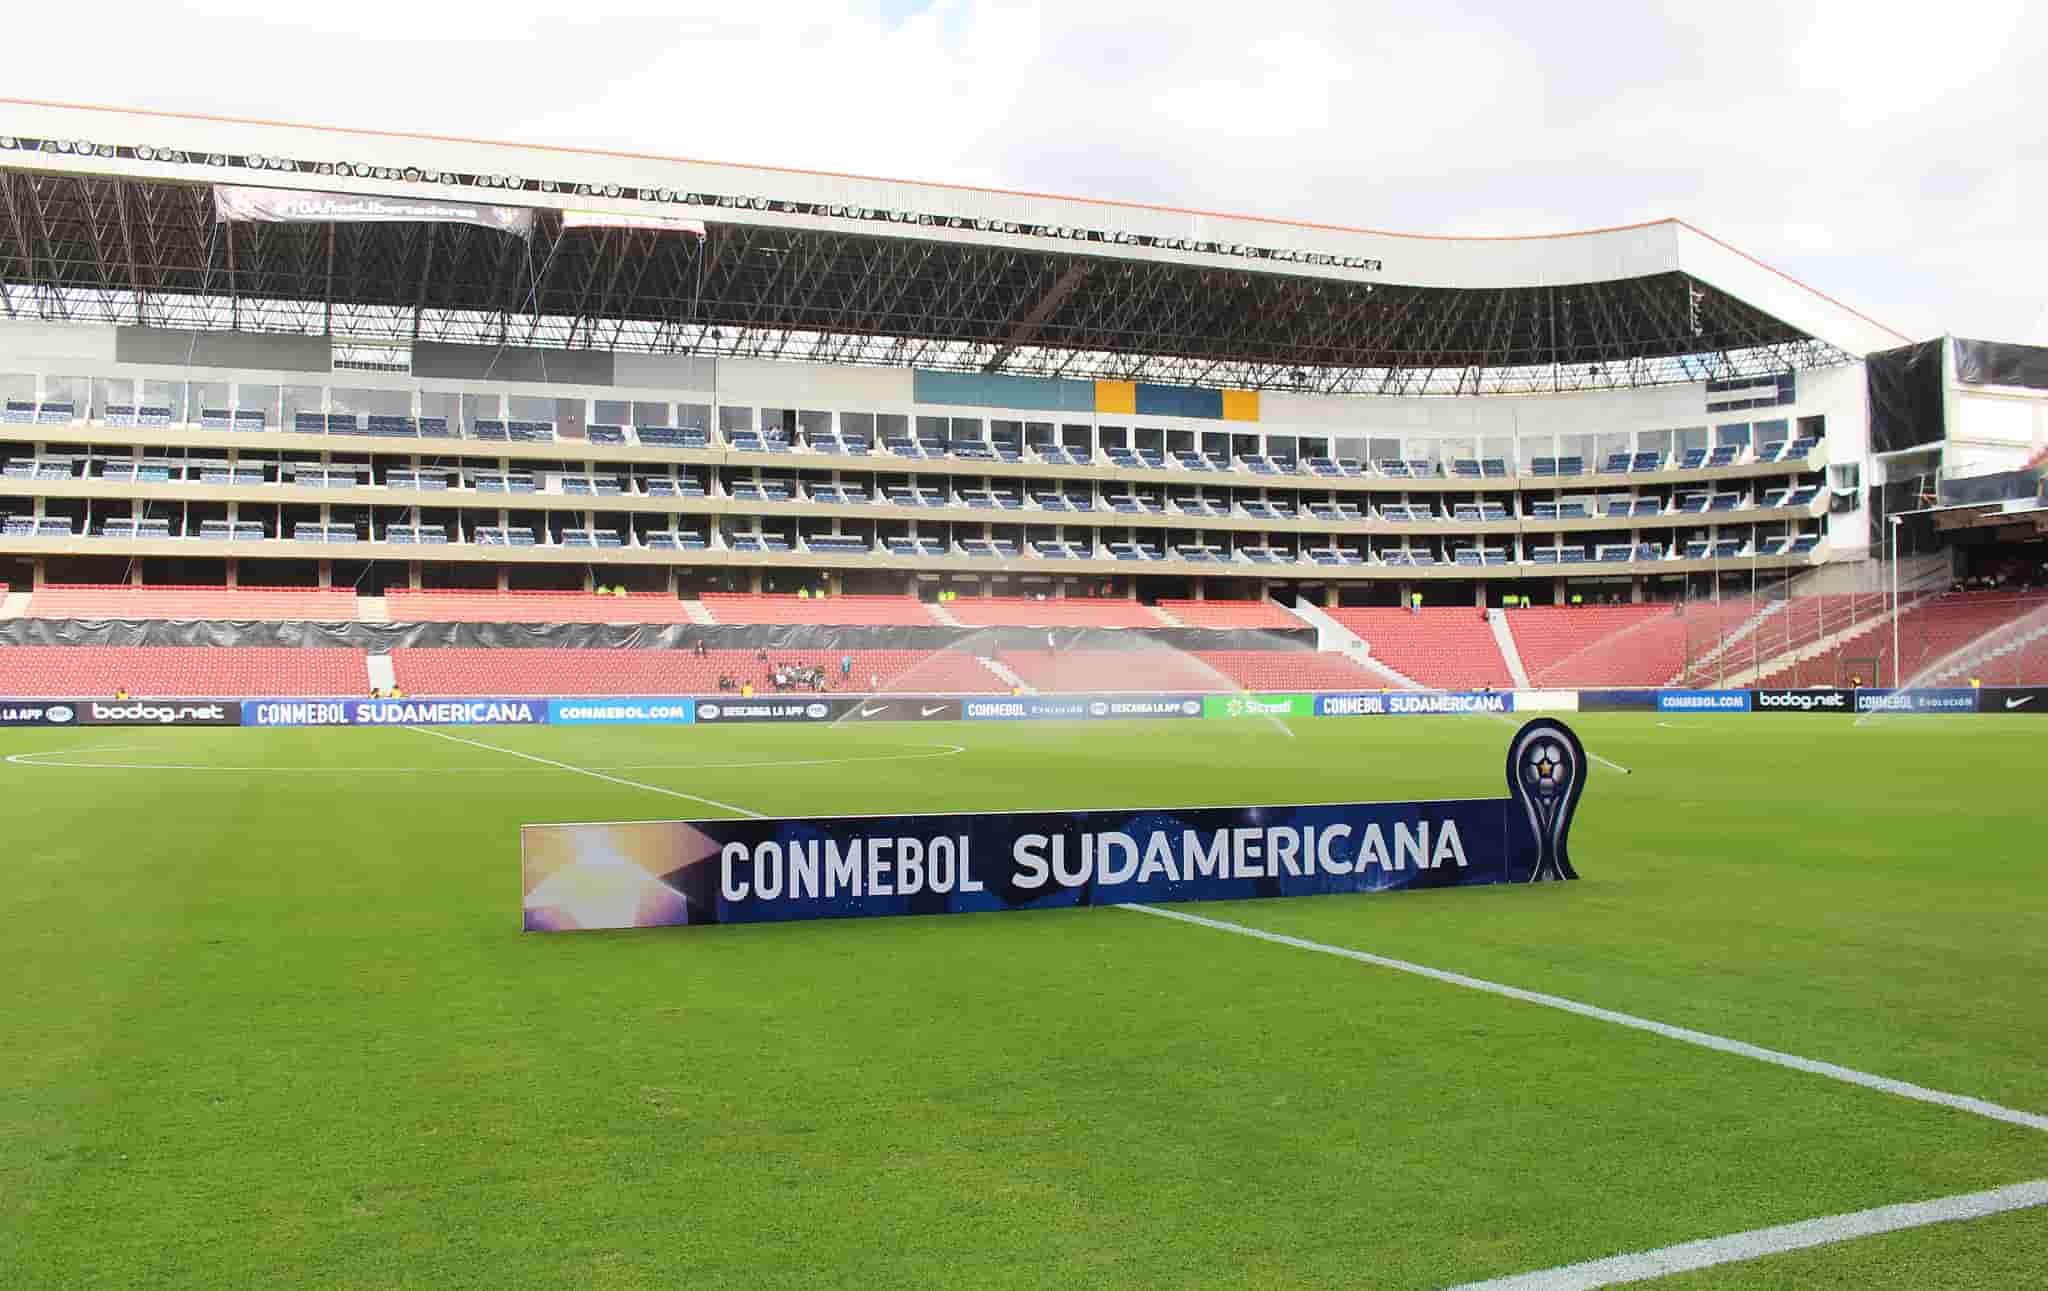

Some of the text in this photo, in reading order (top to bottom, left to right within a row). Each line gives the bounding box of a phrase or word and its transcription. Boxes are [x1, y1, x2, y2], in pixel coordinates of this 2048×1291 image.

[1323, 695, 1504, 714] CONMEBOL SUDAMERICANA
[1663, 696, 1744, 708] CONMEBOL.COM
[1759, 692, 1845, 709] bodog.net
[1859, 695, 1913, 710] CONMEBOL
[92, 702, 225, 722] bodog.net
[257, 703, 533, 723] CONMEBOL SUDAMERICANA
[559, 706, 684, 720] CONMEBOL.COM
[967, 703, 1026, 717] CONMEBOL
[720, 819, 1468, 902] CONMEBOL SUDAMERICANA
